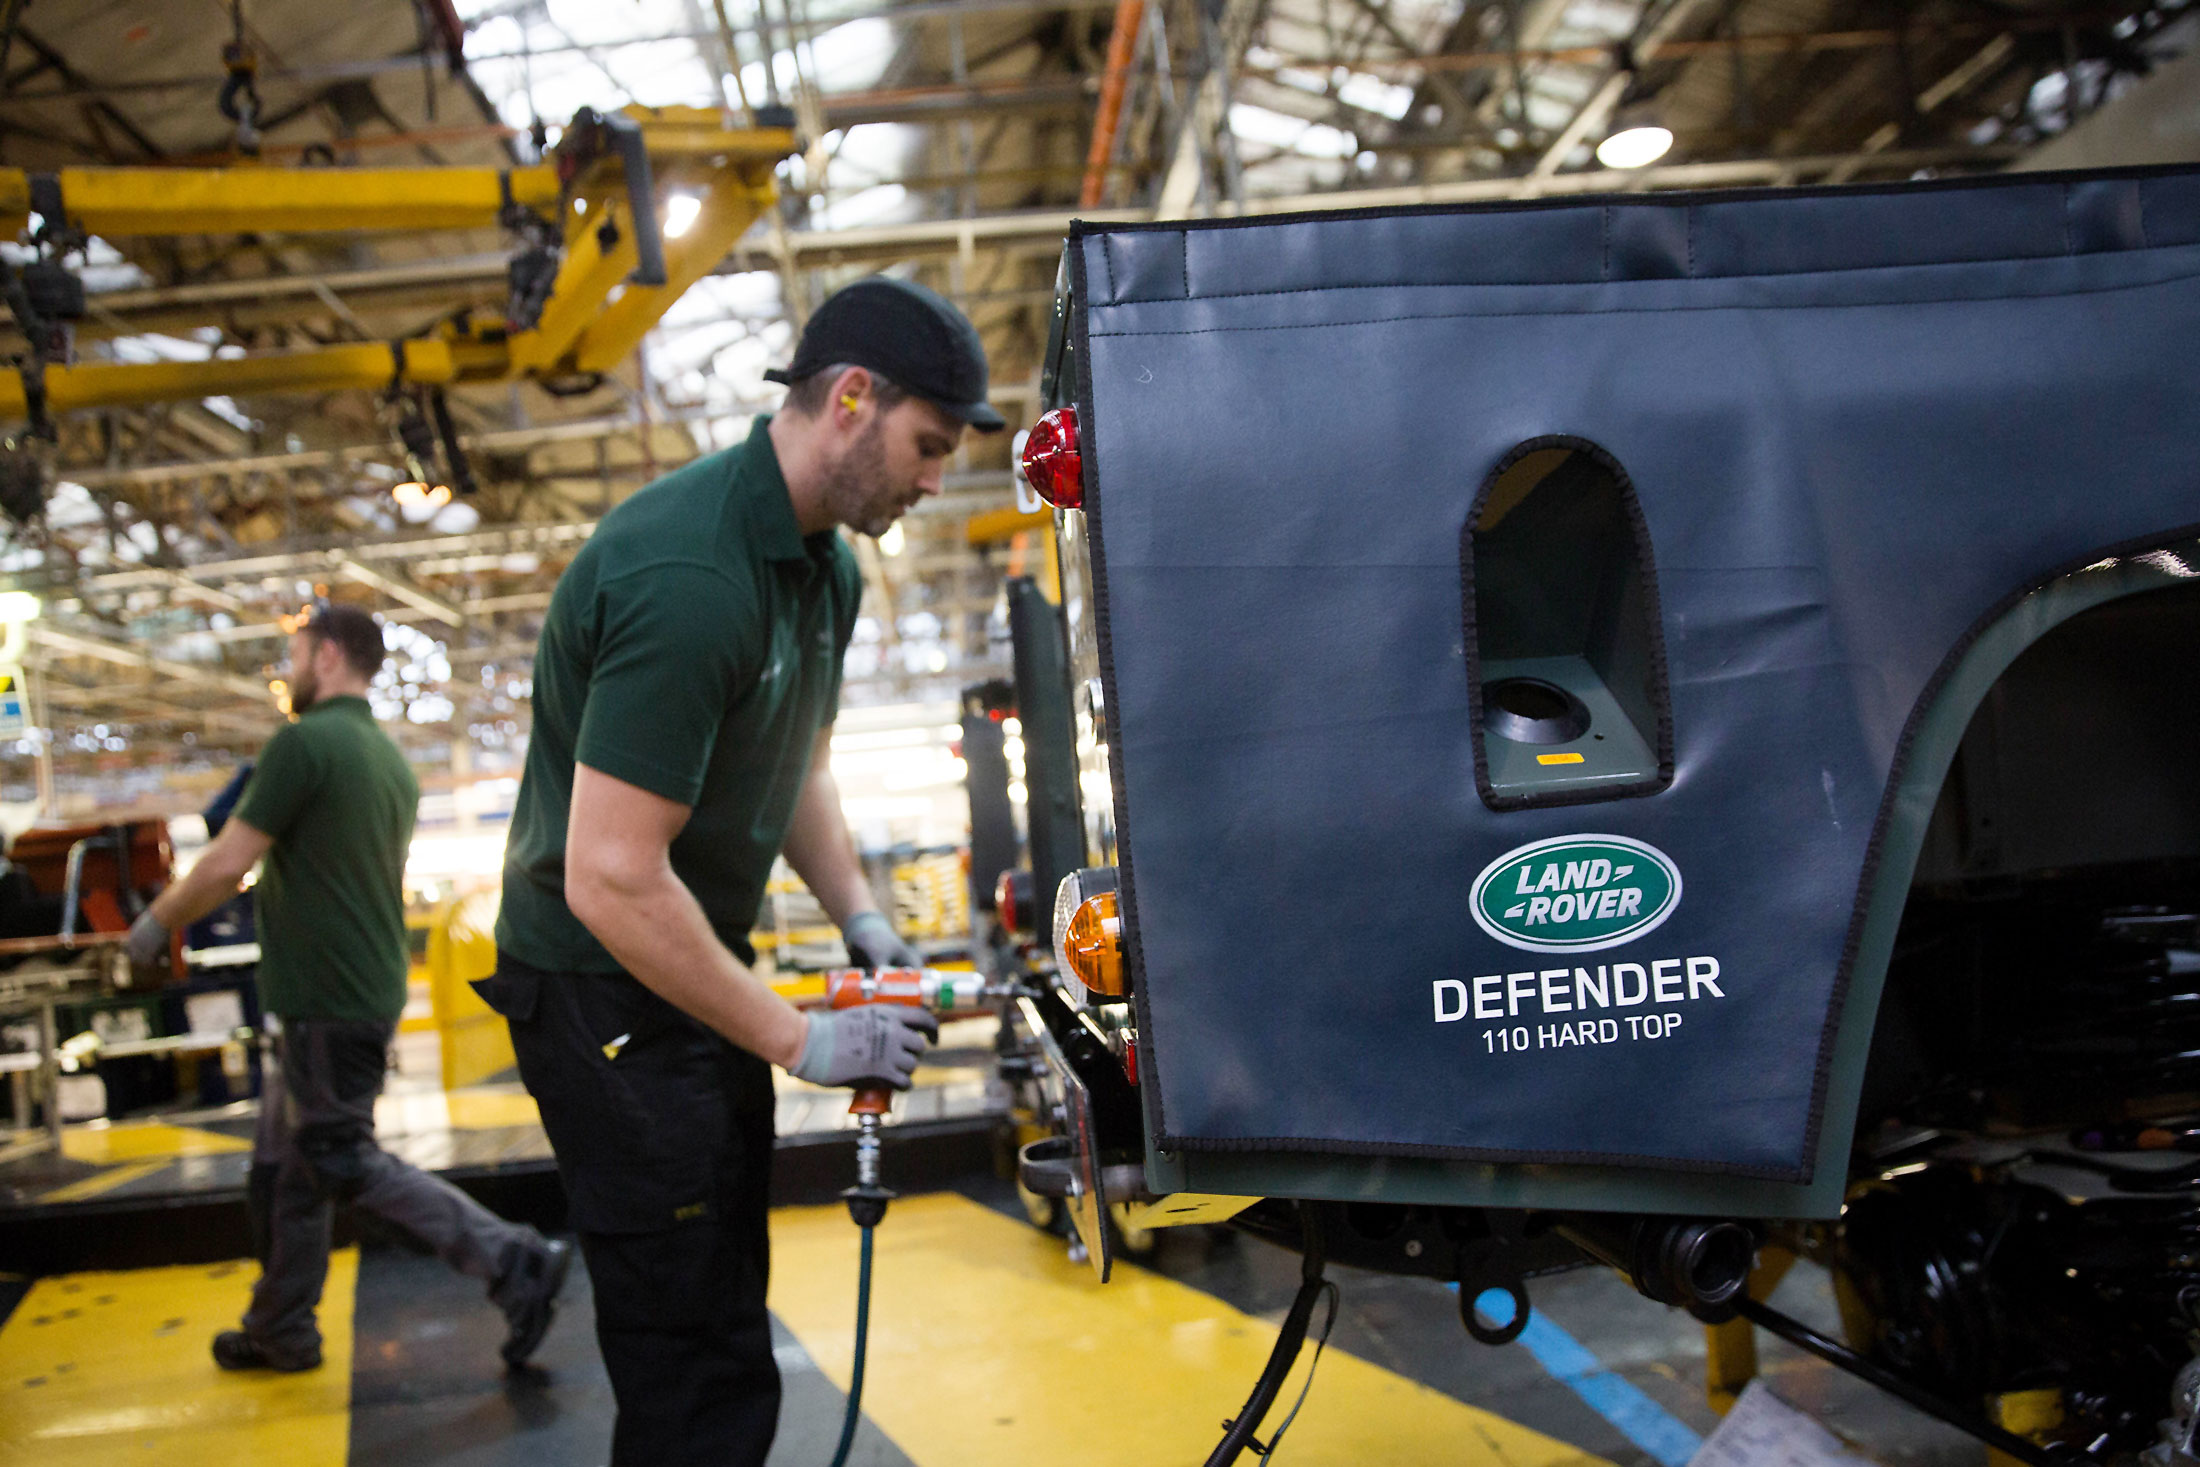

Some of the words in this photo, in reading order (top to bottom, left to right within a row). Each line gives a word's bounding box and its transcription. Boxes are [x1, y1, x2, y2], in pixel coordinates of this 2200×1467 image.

[1432, 956, 1726, 1023] DEFENDER
[1482, 1028, 1530, 1054] 110
[1537, 1018, 1619, 1049] HARD
[1624, 1012, 1683, 1041] TOP
